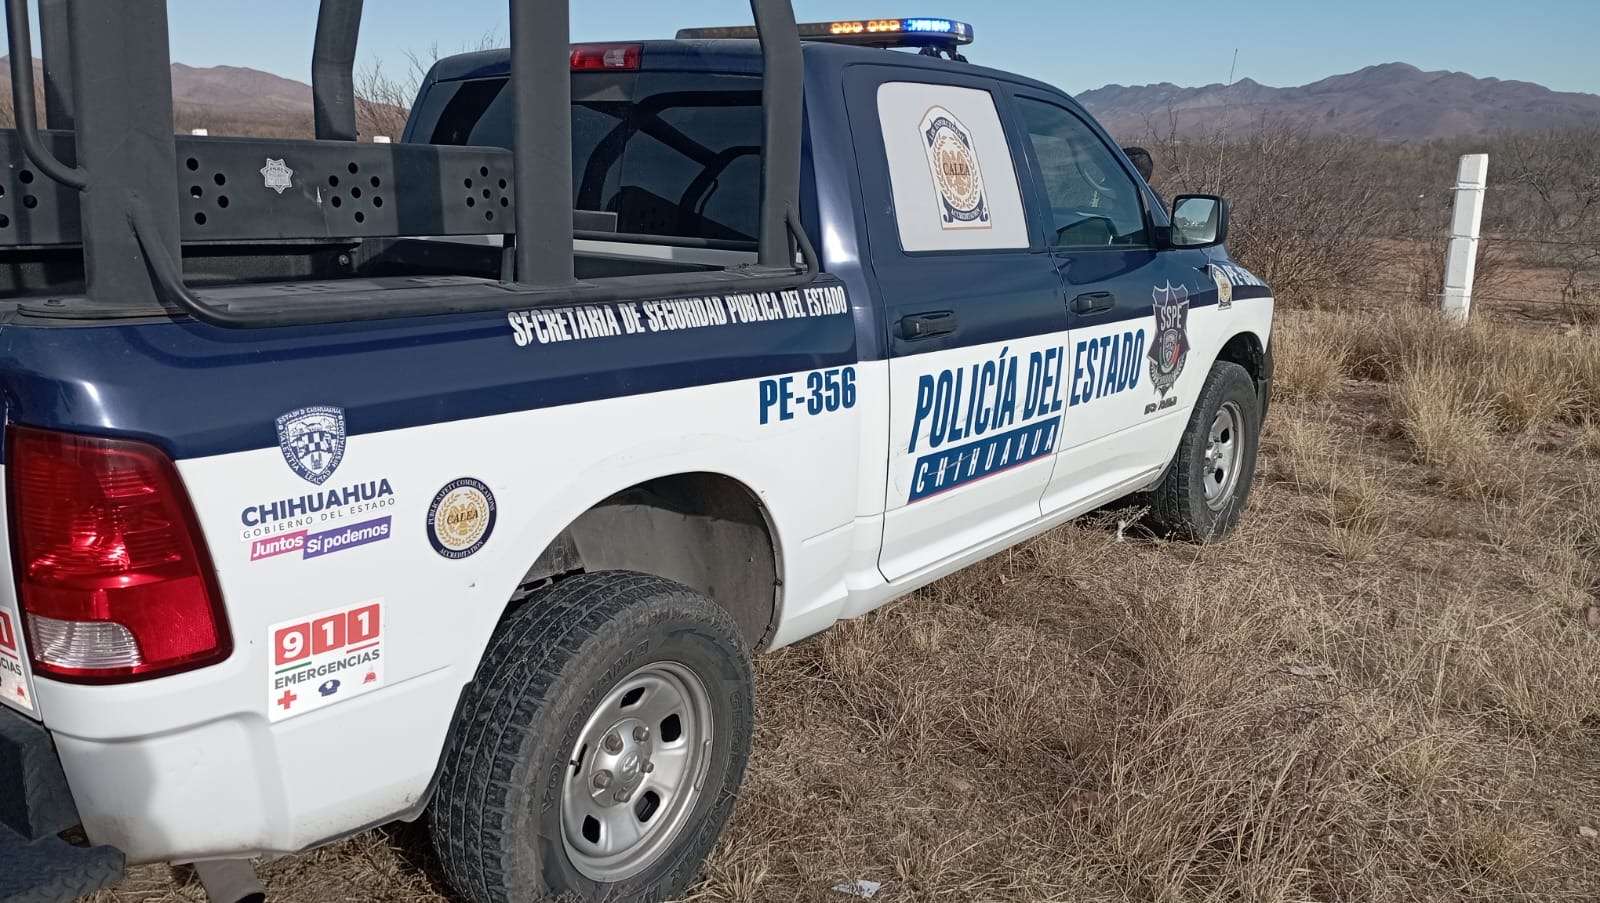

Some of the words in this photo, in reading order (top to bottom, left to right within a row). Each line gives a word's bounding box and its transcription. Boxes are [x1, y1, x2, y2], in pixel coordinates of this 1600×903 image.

[618, 302, 645, 334] DE
[642, 296, 727, 332] SEGURIDAD
[780, 289, 806, 318] DEL
[804, 286, 847, 316] ESTADO
[1160, 304, 1181, 331] SSPE
[759, 367, 856, 425] PE-356
[908, 347, 1017, 453] POLICÍA
[1022, 346, 1063, 420] DEL
[1069, 329, 1145, 407] ESTADO
[916, 424, 1058, 492] CHIHUAHUA
[241, 478, 393, 527] CHIHUAHUA
[243, 516, 313, 539] GOBIERNO
[321, 510, 343, 521] DEL
[350, 498, 395, 514] ESTADO
[447, 510, 478, 525] CALEA
[253, 535, 303, 557] Juntos
[324, 524, 388, 552] podemos
[283, 611, 369, 659] 911
[275, 649, 380, 690] EMERGENCIAS
